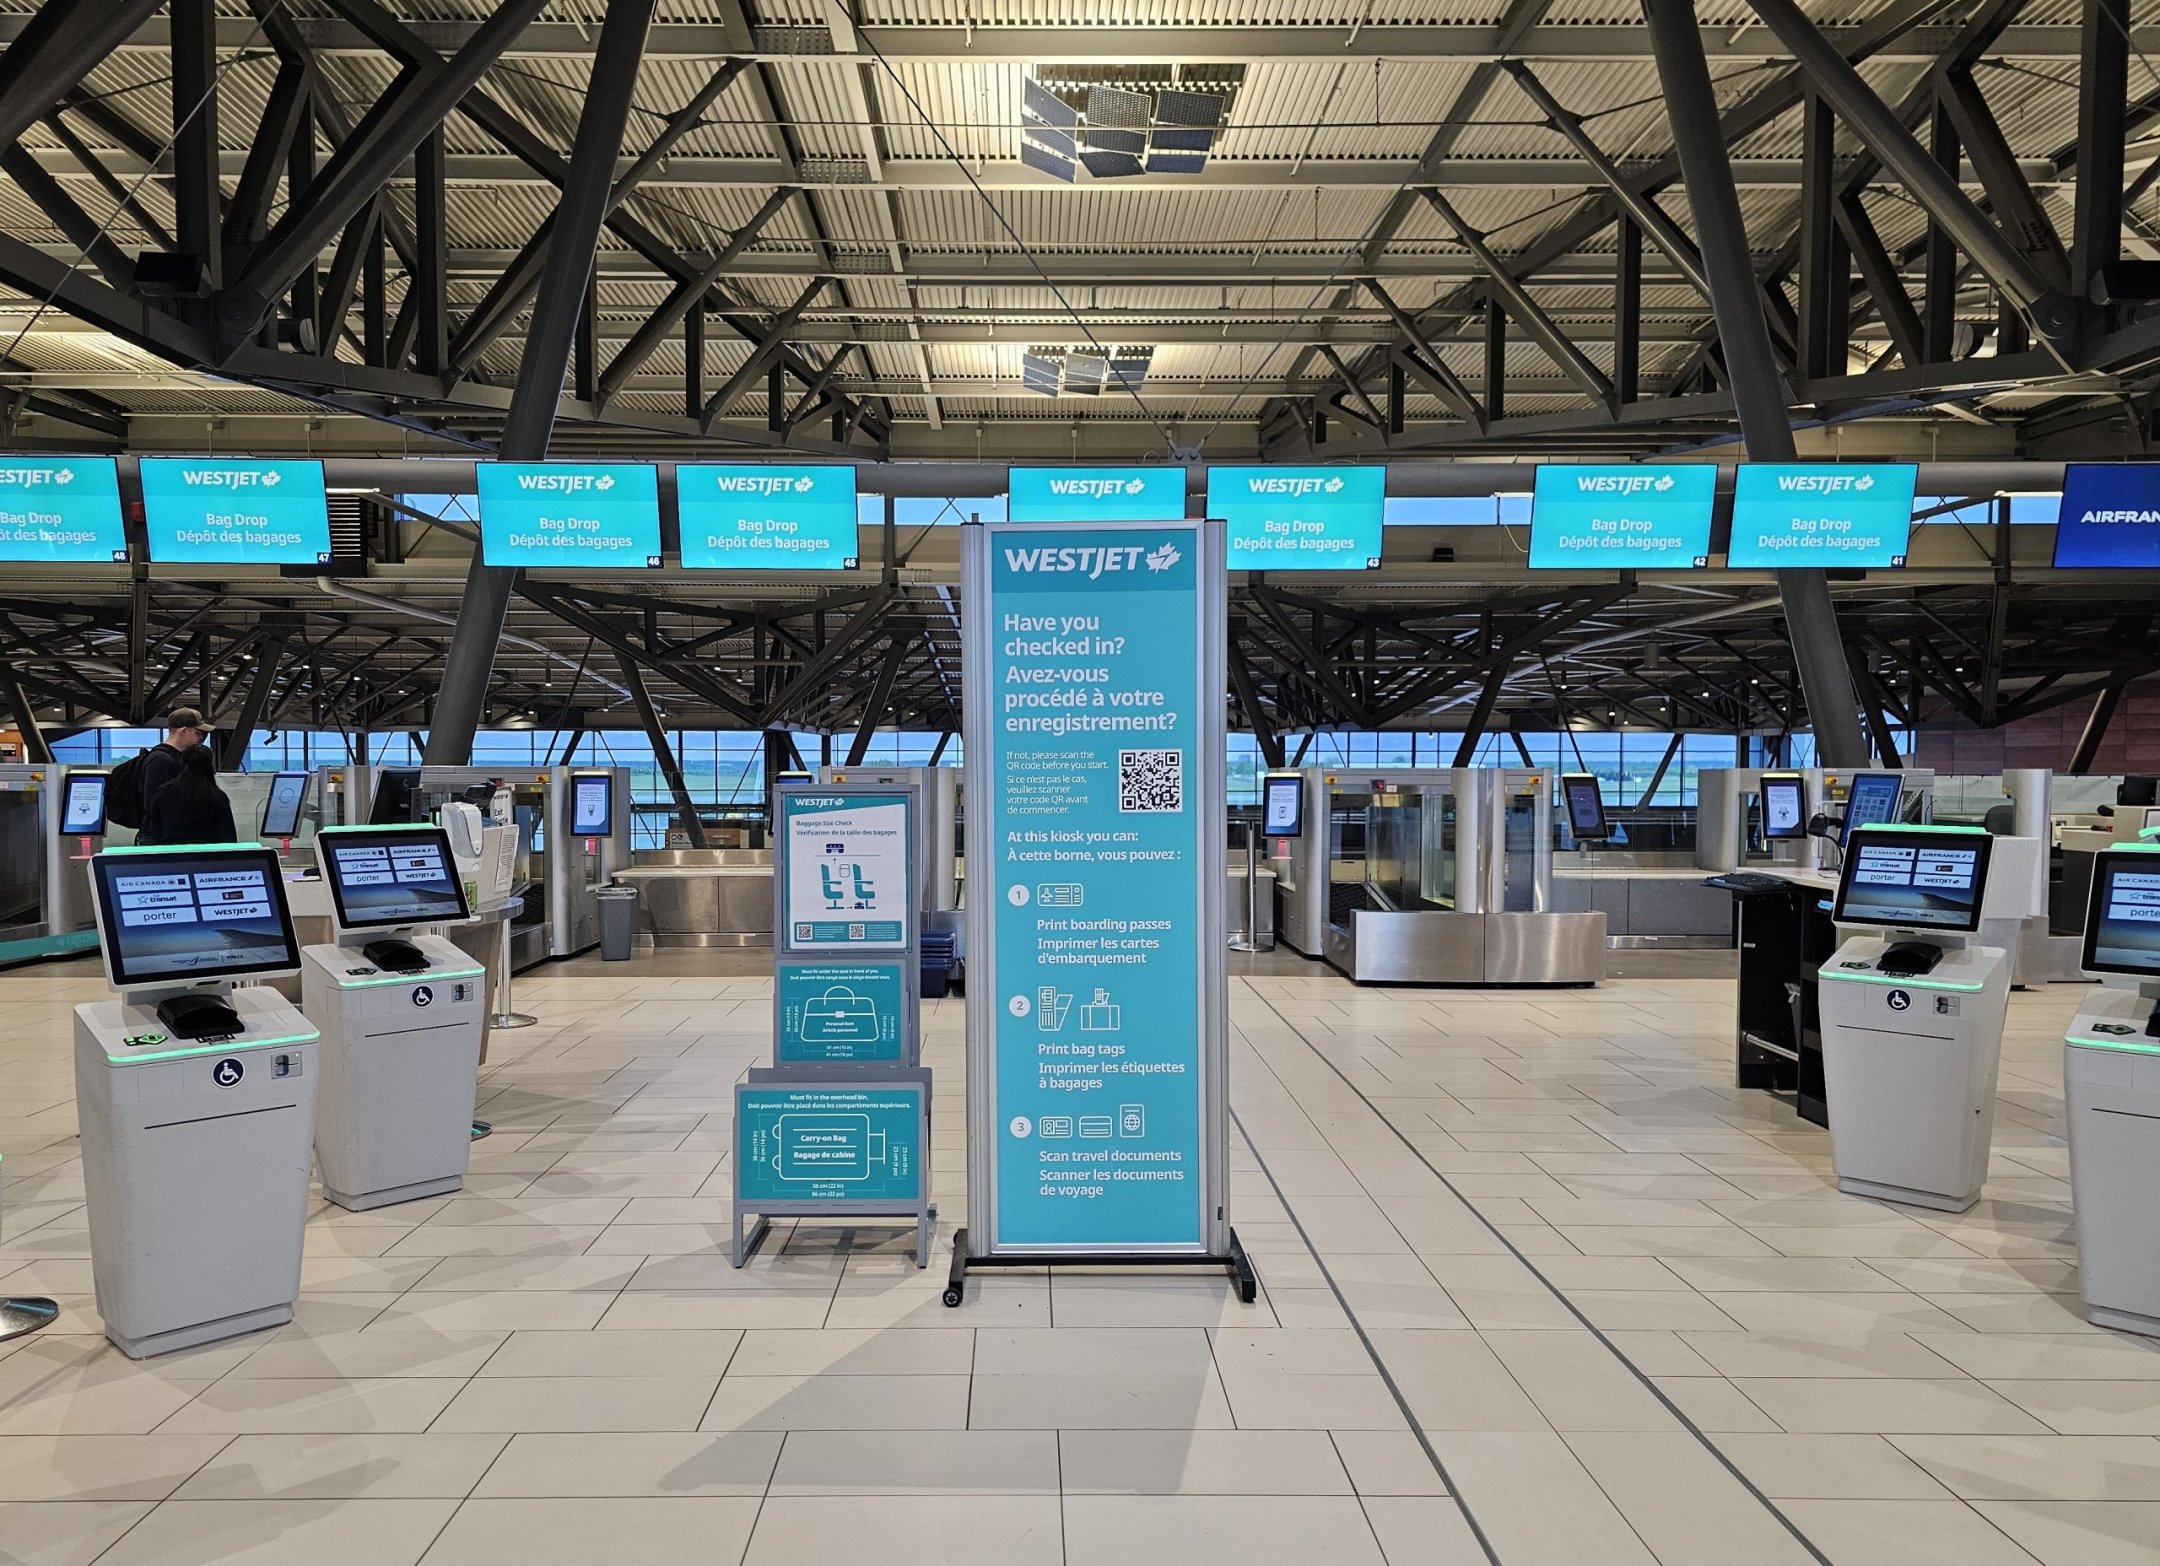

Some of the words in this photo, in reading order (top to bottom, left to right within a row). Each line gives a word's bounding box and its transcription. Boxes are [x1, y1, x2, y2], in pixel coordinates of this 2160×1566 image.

[0, 470, 54, 488] ESTJET
[183, 471, 260, 489] WESTJET
[518, 475, 594, 494] WESTJET
[1577, 476, 1655, 495] WESTJET
[1778, 476, 1856, 495] WESTJET
[718, 478, 794, 496] WESTJET
[1050, 479, 1125, 498] WESTJET
[1249, 478, 1324, 497] WESTJET
[1, 512, 26, 527] Bag
[29, 512, 62, 527] Drop
[206, 513, 231, 526] Bag
[235, 514, 268, 528] Drop
[2081, 511, 2160, 523] AIRFRAN
[540, 518, 564, 531] Bag
[568, 518, 600, 533] Drop
[738, 520, 762, 533] Bag
[766, 520, 798, 534] Drop
[1265, 520, 1289, 535] Bag
[1292, 521, 1324, 535] Drop
[1592, 518, 1616, 532] Bag
[1620, 518, 1653, 533] Drop
[1792, 517, 1816, 531] Bag
[1819, 517, 1852, 532] Drop
[14, 530, 37, 541] des
[40, 530, 96, 544] bagages
[176, 529, 216, 544] Dépôt
[219, 530, 243, 543] des
[246, 531, 301, 546] bagages
[510, 533, 549, 548] Dépôt
[552, 534, 575, 546] des
[577, 535, 632, 549] bagages
[708, 535, 747, 550] Dépôt
[750, 536, 772, 548] des
[775, 537, 830, 551] bagages
[1234, 536, 1272, 551] Dépôt
[1275, 537, 1297, 549] des
[1300, 537, 1354, 552] bagages
[1558, 533, 1598, 549] Dépôt
[1600, 534, 1624, 547] des
[1627, 535, 1682, 550] bagages
[1758, 533, 1798, 549] Dépôt
[1800, 534, 1823, 547] des
[1825, 534, 1880, 549] bagages
[114, 552, 125, 560] 48
[318, 554, 330, 562] 47
[649, 557, 660, 566] 46
[844, 559, 856, 567] 45
[1368, 558, 1380, 567] 43
[1694, 556, 1707, 566] 42
[1892, 556, 1904, 565] 41
[1005, 547, 1144, 580] WESTJET
[1004, 614, 1056, 632] Have
[1060, 616, 1099, 635] you
[1005, 637, 1090, 656] checked
[1095, 637, 1125, 655] in?
[1006, 666, 1109, 683] Avez-vous
[1005, 688, 1088, 712] procédé
[1092, 688, 1104, 706] à
[1109, 691, 1164, 706] votre
[1006, 712, 1177, 736] enregistrement?
[1032, 751, 1059, 761] please
[1007, 762, 1019, 770] QR
[1043, 761, 1069, 769] before
[1070, 763, 1085, 771] you
[1007, 776, 1014, 784] Si
[1047, 776, 1061, 784] pas
[1007, 786, 1037, 794] veuillez
[795, 798, 834, 808] WESTJET
[1052, 796, 1064, 804] QR
[495, 808, 503, 816] Exit
[1008, 806, 1018, 814] de
[1008, 832, 1022, 842] At
[1025, 831, 1048, 841] this
[1051, 831, 1084, 841] kiosk
[1086, 832, 1109, 844] you
[1113, 832, 1138, 841] can:
[1008, 848, 1017, 860] À
[1020, 850, 1051, 860] cette
[1054, 850, 1094, 861] borne,
[1097, 851, 1126, 860] vous
[1016, 891, 1022, 900] 1
[144, 912, 176, 921] porter
[214, 908, 248, 916] WESTJET
[1037, 920, 1068, 930] Print
[1071, 919, 1127, 932] boarding
[1130, 920, 1171, 932] passes
[1038, 938, 1098, 952] Imprimer
[1101, 938, 1118, 948] les
[1121, 938, 1159, 948] cartes
[1038, 952, 1147, 966] d'embarquement
[1017, 1002, 1023, 1010] 2
[1038, 1044, 1069, 1054] Print
[1072, 1043, 1095, 1056] bag
[1098, 1044, 1125, 1056] tags
[1039, 1063, 1099, 1076] Imprimer
[1102, 1062, 1118, 1072] les
[1121, 1062, 1185, 1076] étiquettes
[1039, 1077, 1047, 1088] à
[1050, 1078, 1102, 1091] bagages
[1018, 1123, 1024, 1131] 3
[801, 1135, 831, 1143] Carry-on
[834, 1135, 846, 1143] Bag
[1040, 1151, 1069, 1162] Scan
[1072, 1150, 1108, 1161] travel
[1111, 1151, 1181, 1161] documents
[1040, 1170, 1091, 1180] Scanner
[1094, 1169, 1110, 1180] les
[1113, 1170, 1184, 1180] documents
[1040, 1185, 1056, 1195] de
[1058, 1186, 1103, 1198] voyage
